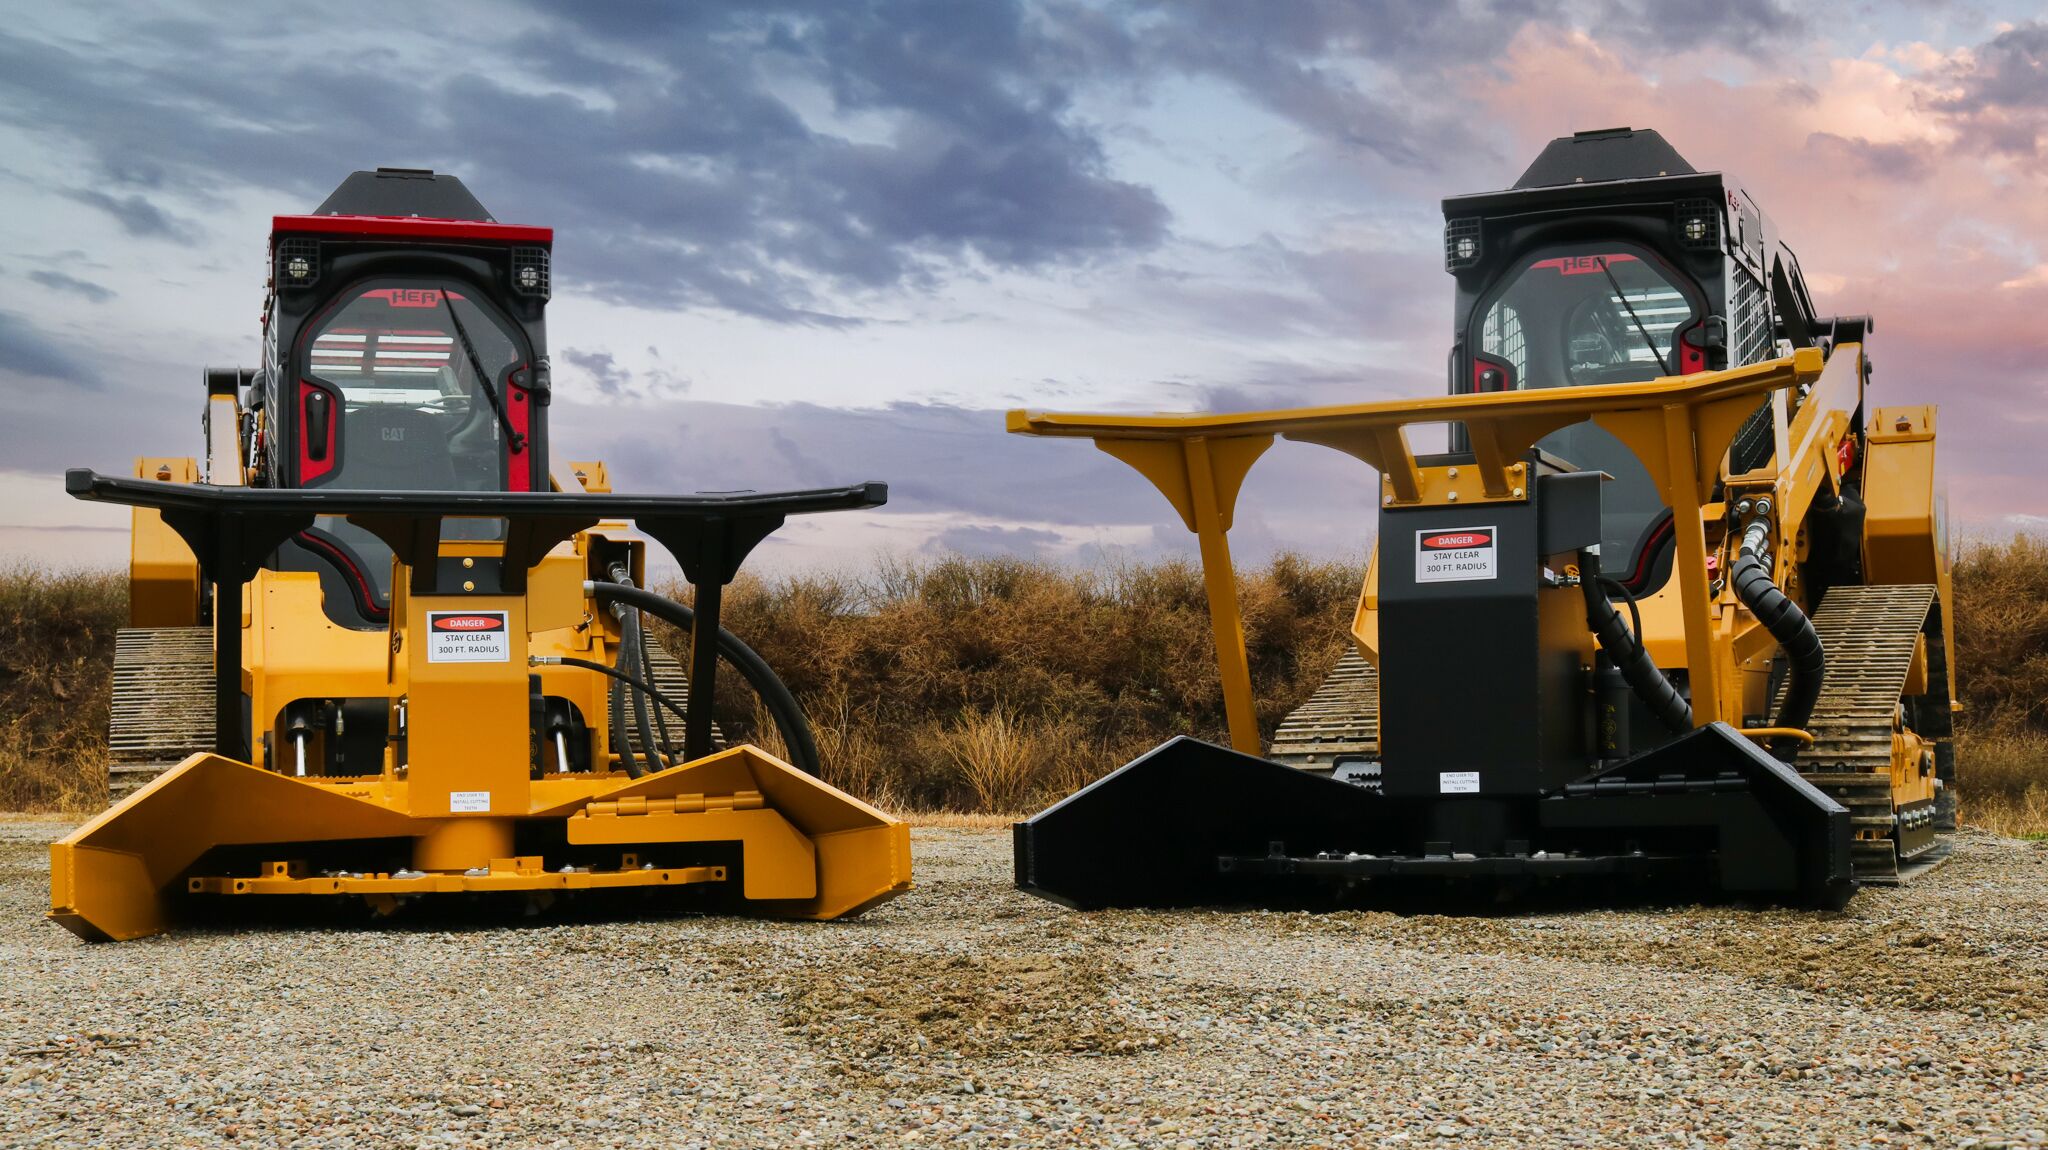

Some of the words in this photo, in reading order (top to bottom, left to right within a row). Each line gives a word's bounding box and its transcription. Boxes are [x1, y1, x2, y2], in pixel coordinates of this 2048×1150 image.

[392, 289, 436, 304] HEA
[382, 427, 405, 441] CAT
[1438, 535, 1473, 545] DANGER
[1433, 552, 1452, 560] STAY
[1454, 550, 1480, 559] CLEAR
[1426, 565, 1441, 573] 300
[1443, 564, 1454, 572] FT.
[1456, 562, 1487, 571] RADIUS
[449, 619, 485, 627] DANGER
[445, 634, 464, 642] STAY
[466, 634, 491, 642] CLEAR
[438, 646, 453, 654] 300
[455, 645, 466, 653] FT.
[468, 645, 500, 653] RADIUS
